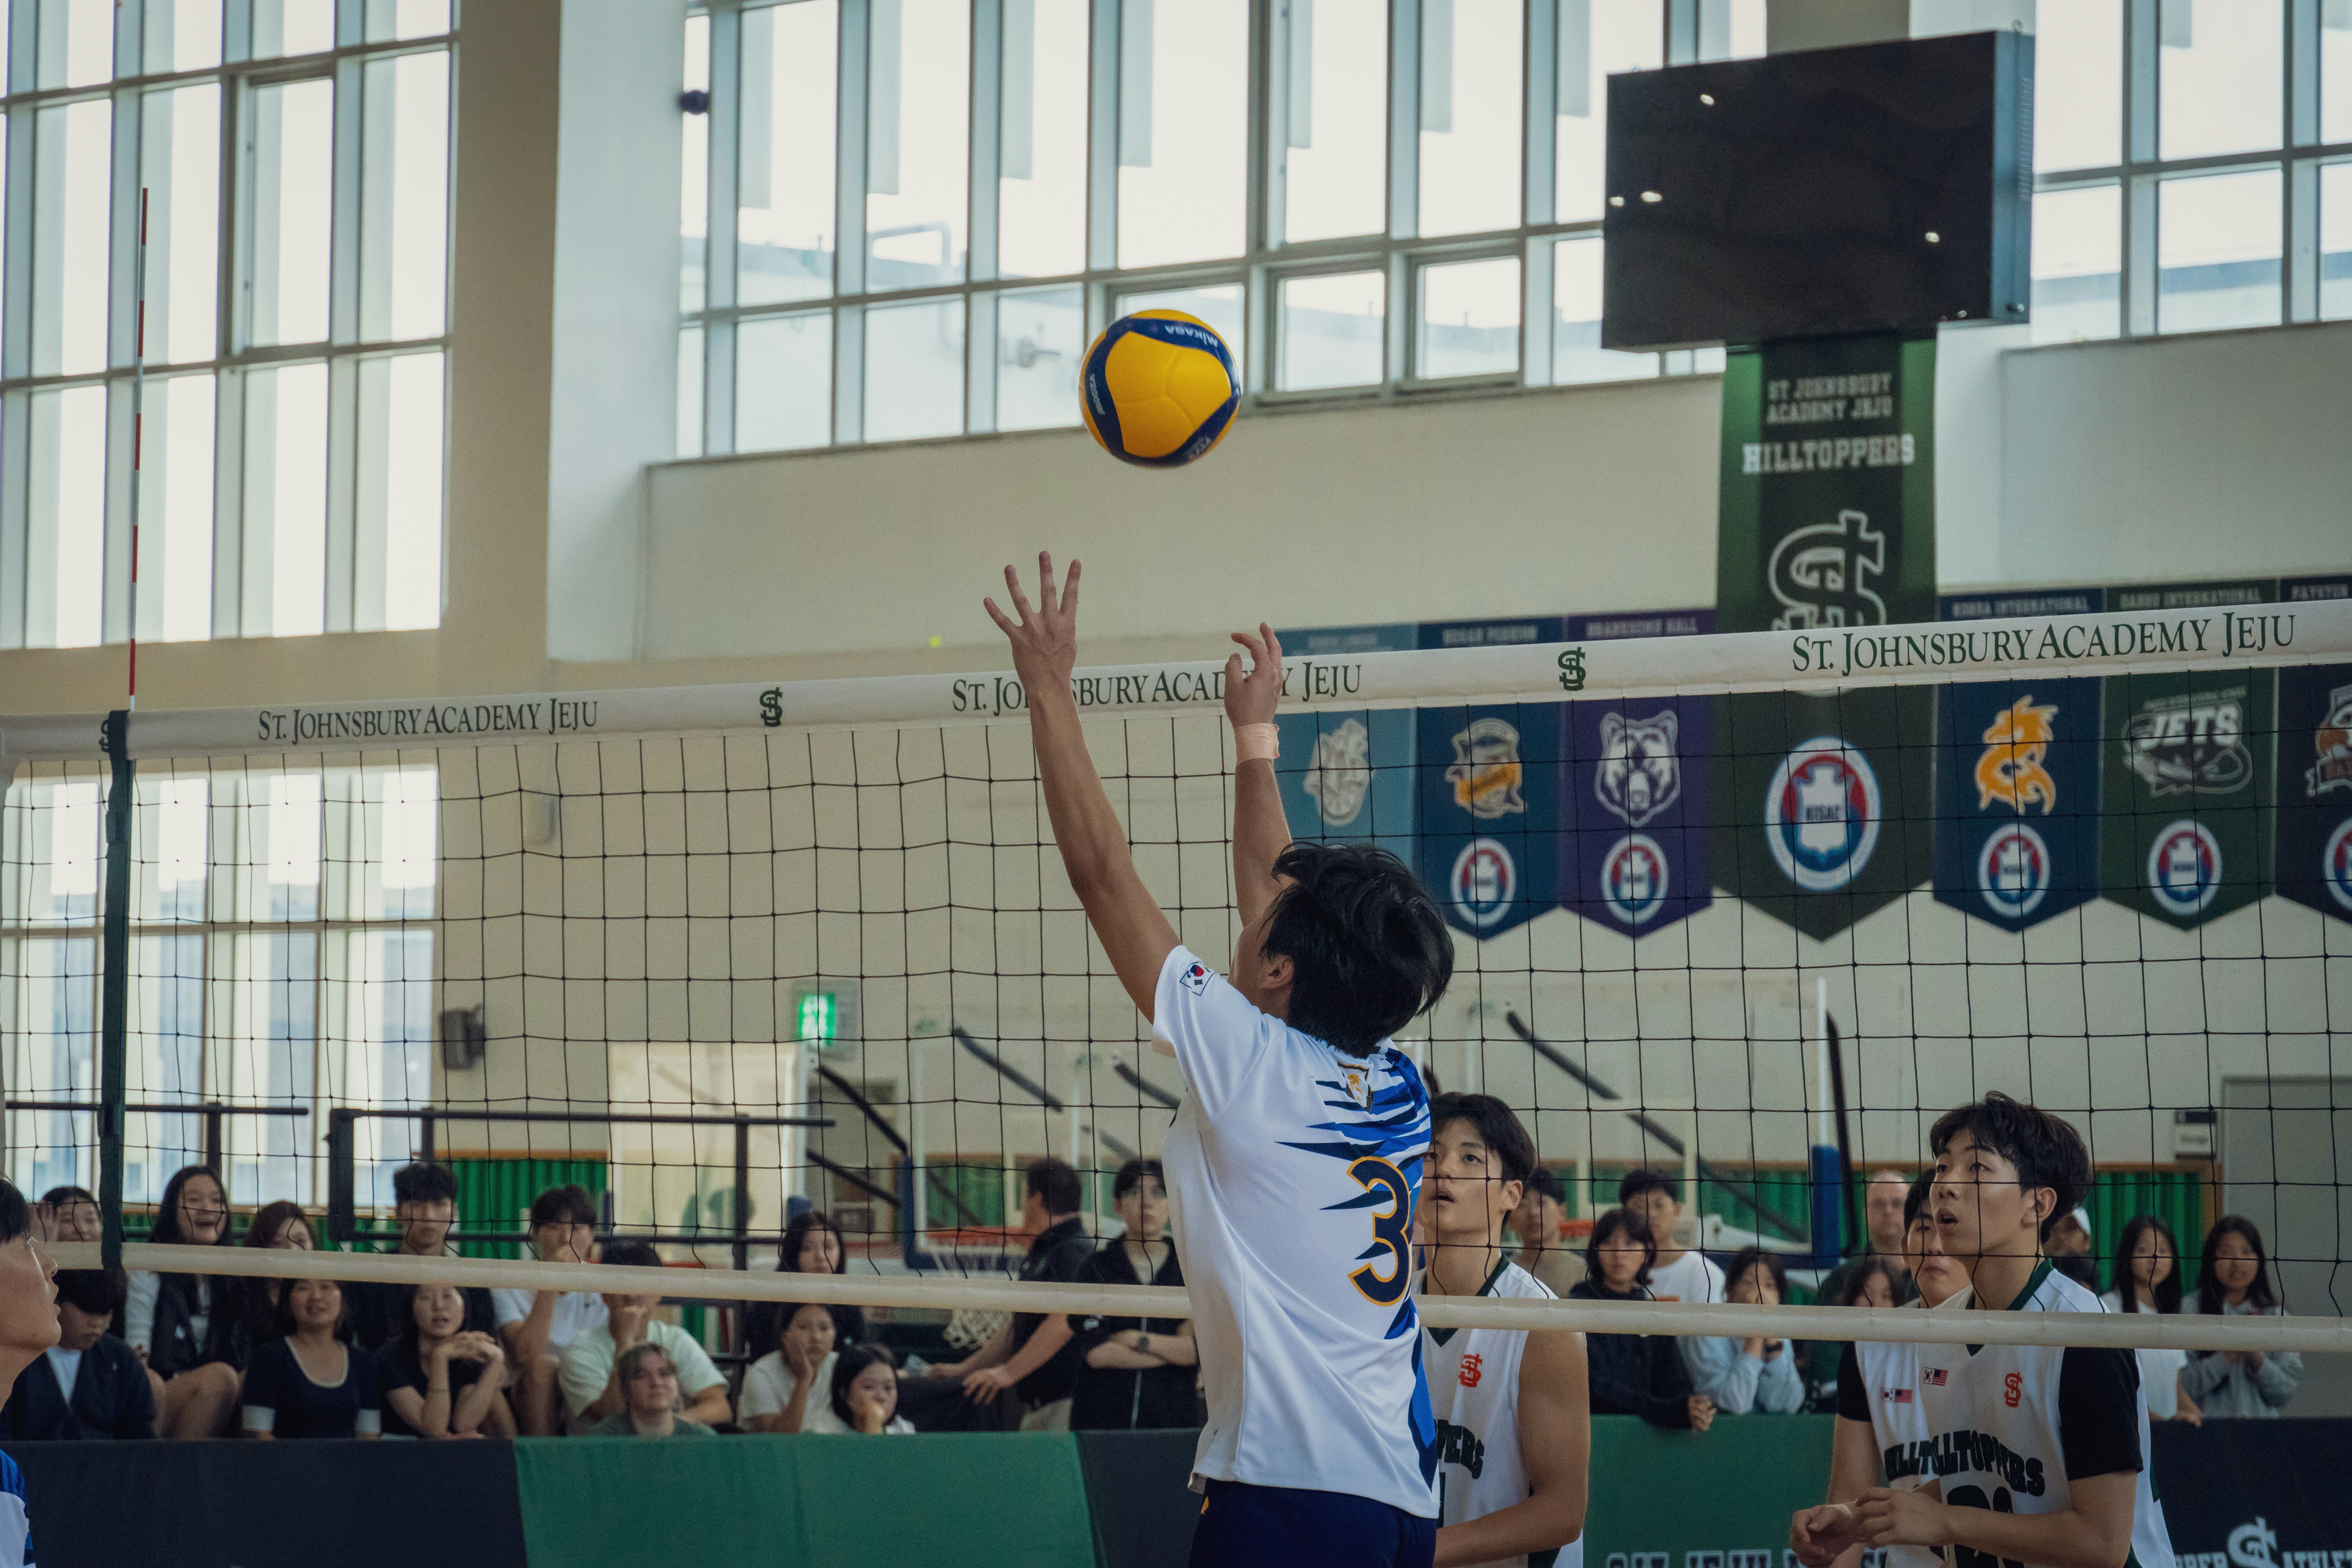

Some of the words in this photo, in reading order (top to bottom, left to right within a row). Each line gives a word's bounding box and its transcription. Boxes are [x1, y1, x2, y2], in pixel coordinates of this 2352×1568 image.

[1742, 433, 1915, 474] HILLTOPPERS
[1842, 629, 2033, 677] JOHNSBURY
[2036, 619, 2211, 659] ACADEMY
[2222, 612, 2296, 658] JEJU
[993, 675, 1149, 716] JOBURY
[1151, 668, 1294, 702] ACADY
[1302, 662, 1362, 702] JEJU
[292, 708, 422, 745] JOHNSBURY
[423, 703, 542, 734] ACADEMY
[549, 698, 599, 735] JEJU
[2139, 703, 2239, 751] JETS
[1347, 1156, 1411, 1307] 3
